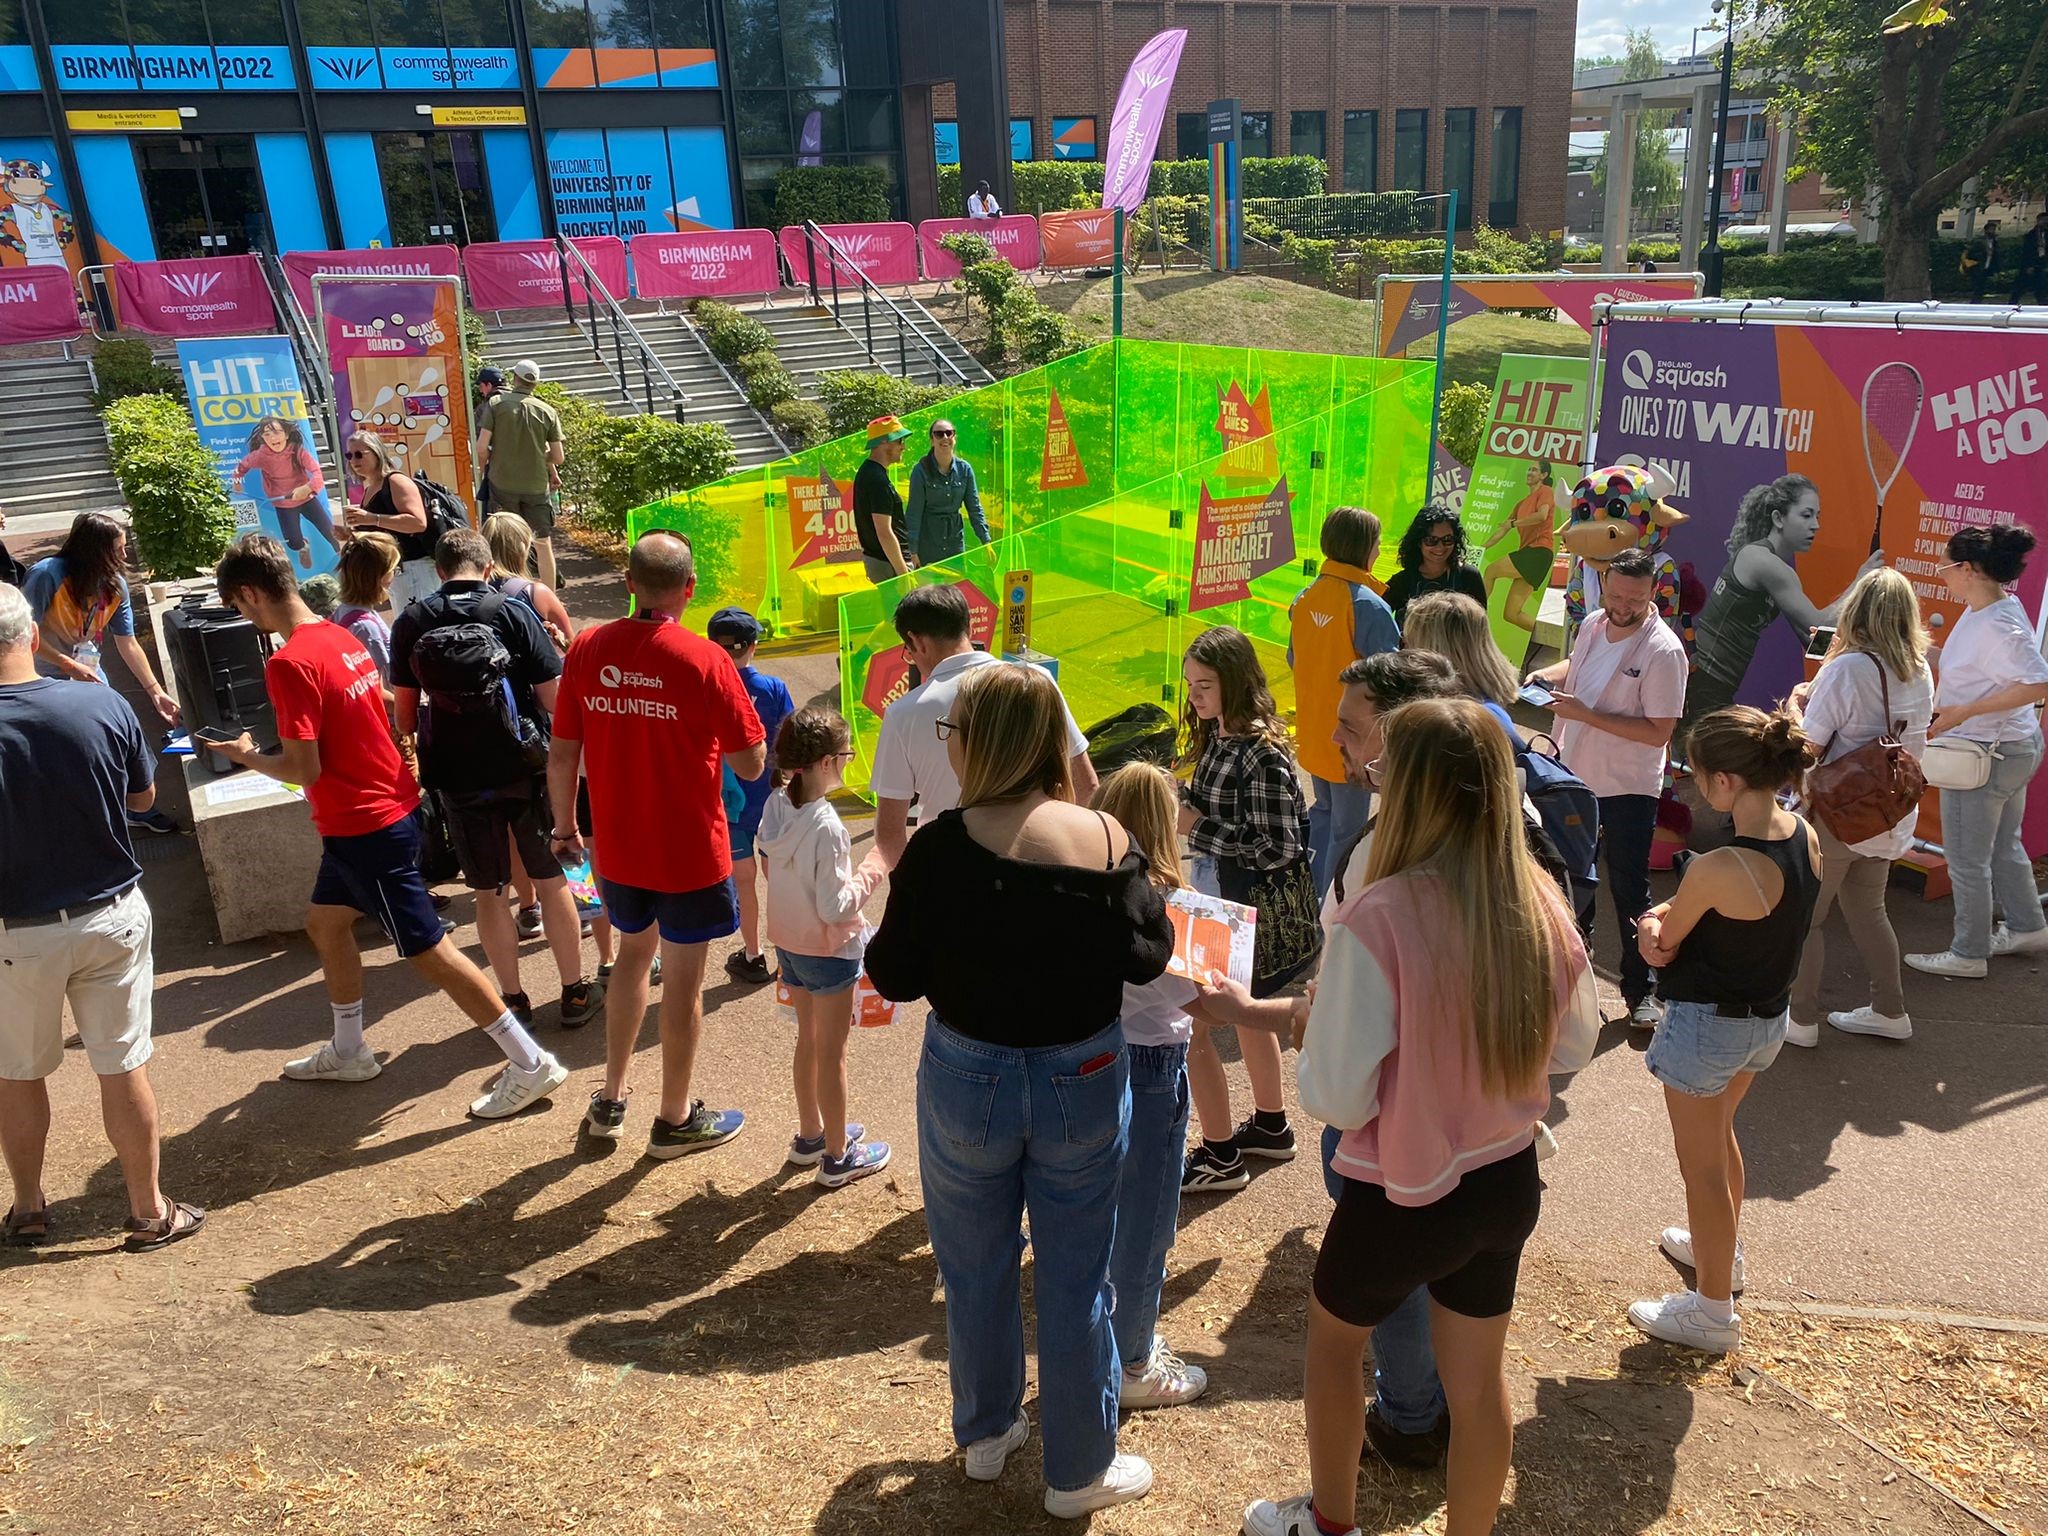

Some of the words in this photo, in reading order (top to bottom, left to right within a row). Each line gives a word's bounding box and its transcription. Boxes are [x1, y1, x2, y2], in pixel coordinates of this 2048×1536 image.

[61, 56, 211, 79] BIRMINGHAM
[219, 57, 274, 79] 2022
[393, 56, 508, 69] commonwealth
[432, 69, 475, 83] sport
[1113, 97, 1144, 195] commonwealth
[1129, 132, 1145, 167] sport
[550, 159, 593, 174] WELCOME
[593, 158, 606, 173] TO
[553, 176, 633, 194] UNIVERSITY
[636, 175, 652, 191] OF
[557, 196, 646, 215] BIRMINGHAM
[561, 220, 614, 239] HOCKEY
[620, 219, 647, 236] AND
[658, 244, 753, 265] BIRMINGHAM
[690, 262, 727, 281] 2022
[160, 301, 238, 313] commonwealth
[186, 311, 214, 321] sport
[367, 338, 406, 351] BOARD
[424, 330, 446, 347] GO
[1657, 360, 1693, 369] ENGLAND
[188, 357, 265, 396] HIT
[263, 377, 296, 391] THE
[1655, 365, 1728, 391] squash
[1494, 378, 1573, 426] HIT
[1930, 362, 2044, 432] HAVE
[203, 396, 297, 422] COURT
[1221, 400, 1239, 416] THE
[1224, 414, 1249, 433] GAMES
[1619, 394, 1663, 438] ONES
[1665, 399, 1687, 440] TO
[1692, 400, 1815, 453] WATCH
[1490, 426, 1582, 461] COURT
[1957, 428, 1974, 457] A
[1977, 408, 2048, 464] GO
[1227, 440, 1265, 473] SQUASH
[1478, 474, 1497, 486] Find
[1496, 478, 1516, 488] your
[792, 485, 815, 499] THERE
[816, 484, 829, 496] ARE
[1475, 488, 1505, 499] nearest
[1954, 483, 1974, 500] AGED
[1974, 485, 1985, 501] 25
[802, 499, 822, 512] MORE
[822, 497, 842, 510] THAN
[1207, 506, 1218, 515] The
[1219, 504, 1242, 514] world's
[1243, 502, 1264, 511] oldest
[1264, 500, 1284, 509] active
[1471, 500, 1499, 511] squash
[1919, 501, 1944, 518] WORLD
[1944, 503, 1962, 521] NO.9
[1963, 505, 1992, 525] (RISING
[1992, 509, 2016, 526] FROM
[1207, 514, 1231, 523] female
[1231, 511, 1254, 521] squash
[1254, 509, 1275, 520] player
[1275, 508, 1281, 516] is
[1468, 511, 1491, 521] court
[1216, 519, 1269, 538] 85-YEAR-OLD
[1465, 521, 1492, 534] NOW!
[1919, 518, 1931, 533] 167
[1931, 520, 1940, 534] IN
[1940, 521, 1959, 536] LESS
[837, 534, 858, 544] COUR
[1914, 538, 1921, 553] 9
[1920, 539, 1934, 555] PSA
[1200, 531, 1274, 567] MARGARET
[1196, 561, 1252, 586] ARMSTRONG
[1895, 557, 1934, 577] GRADUATED
[1199, 585, 1216, 595] from
[1215, 583, 1239, 593] Suffolk
[1912, 581, 1937, 599] SMART
[1010, 605, 1025, 615] HAND
[1009, 615, 1025, 627] SAN
[623, 675, 663, 689] squash
[583, 695, 678, 721] VOLUNTEER
